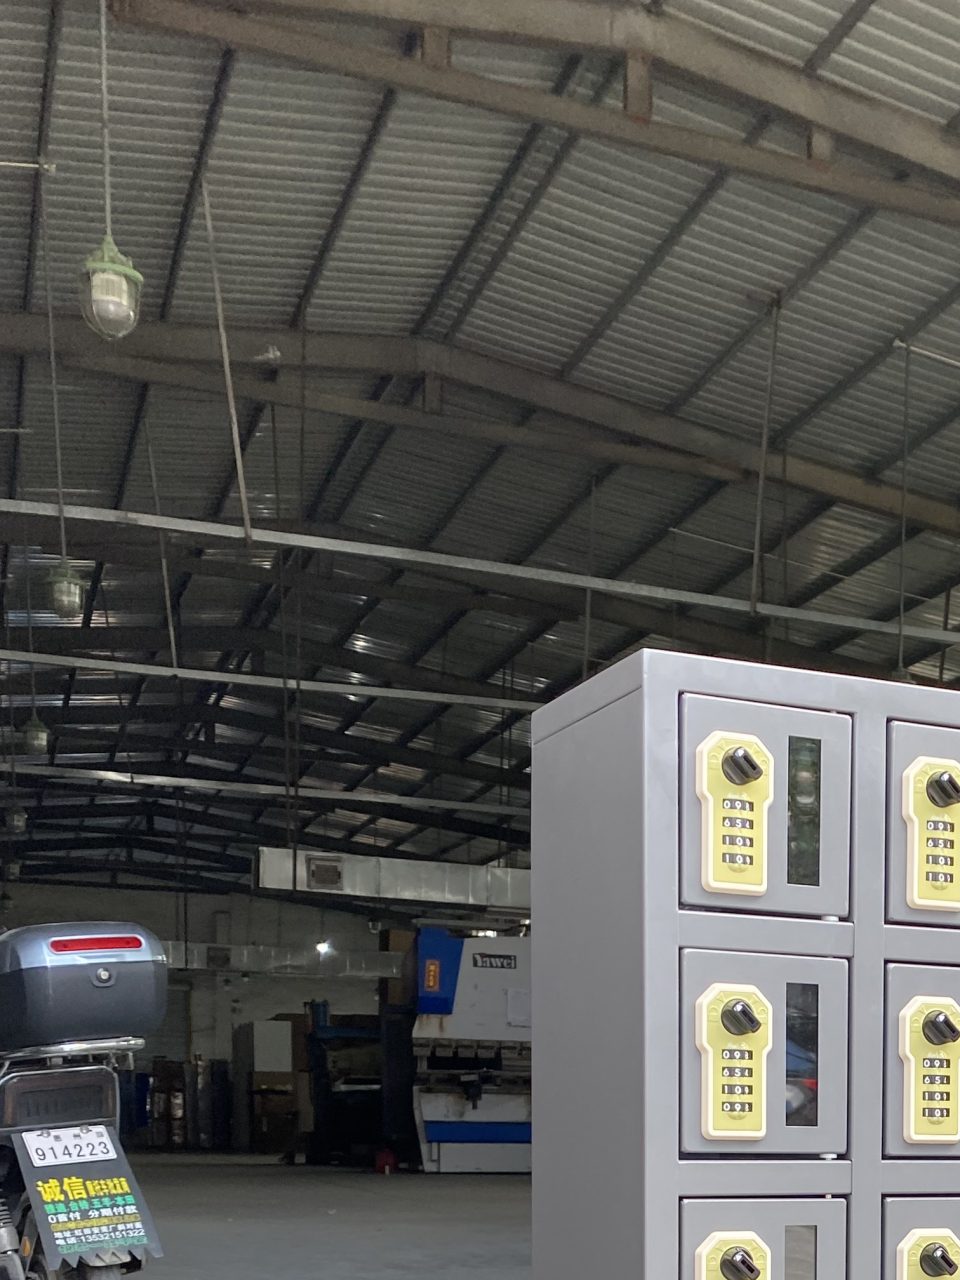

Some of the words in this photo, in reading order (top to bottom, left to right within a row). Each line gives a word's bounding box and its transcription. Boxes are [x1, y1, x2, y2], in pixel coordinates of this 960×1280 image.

[35, 1142, 110, 1160] 914223
[37, 1177, 88, 1201] 诚信
[88, 1205, 139, 1219] 分期付款
